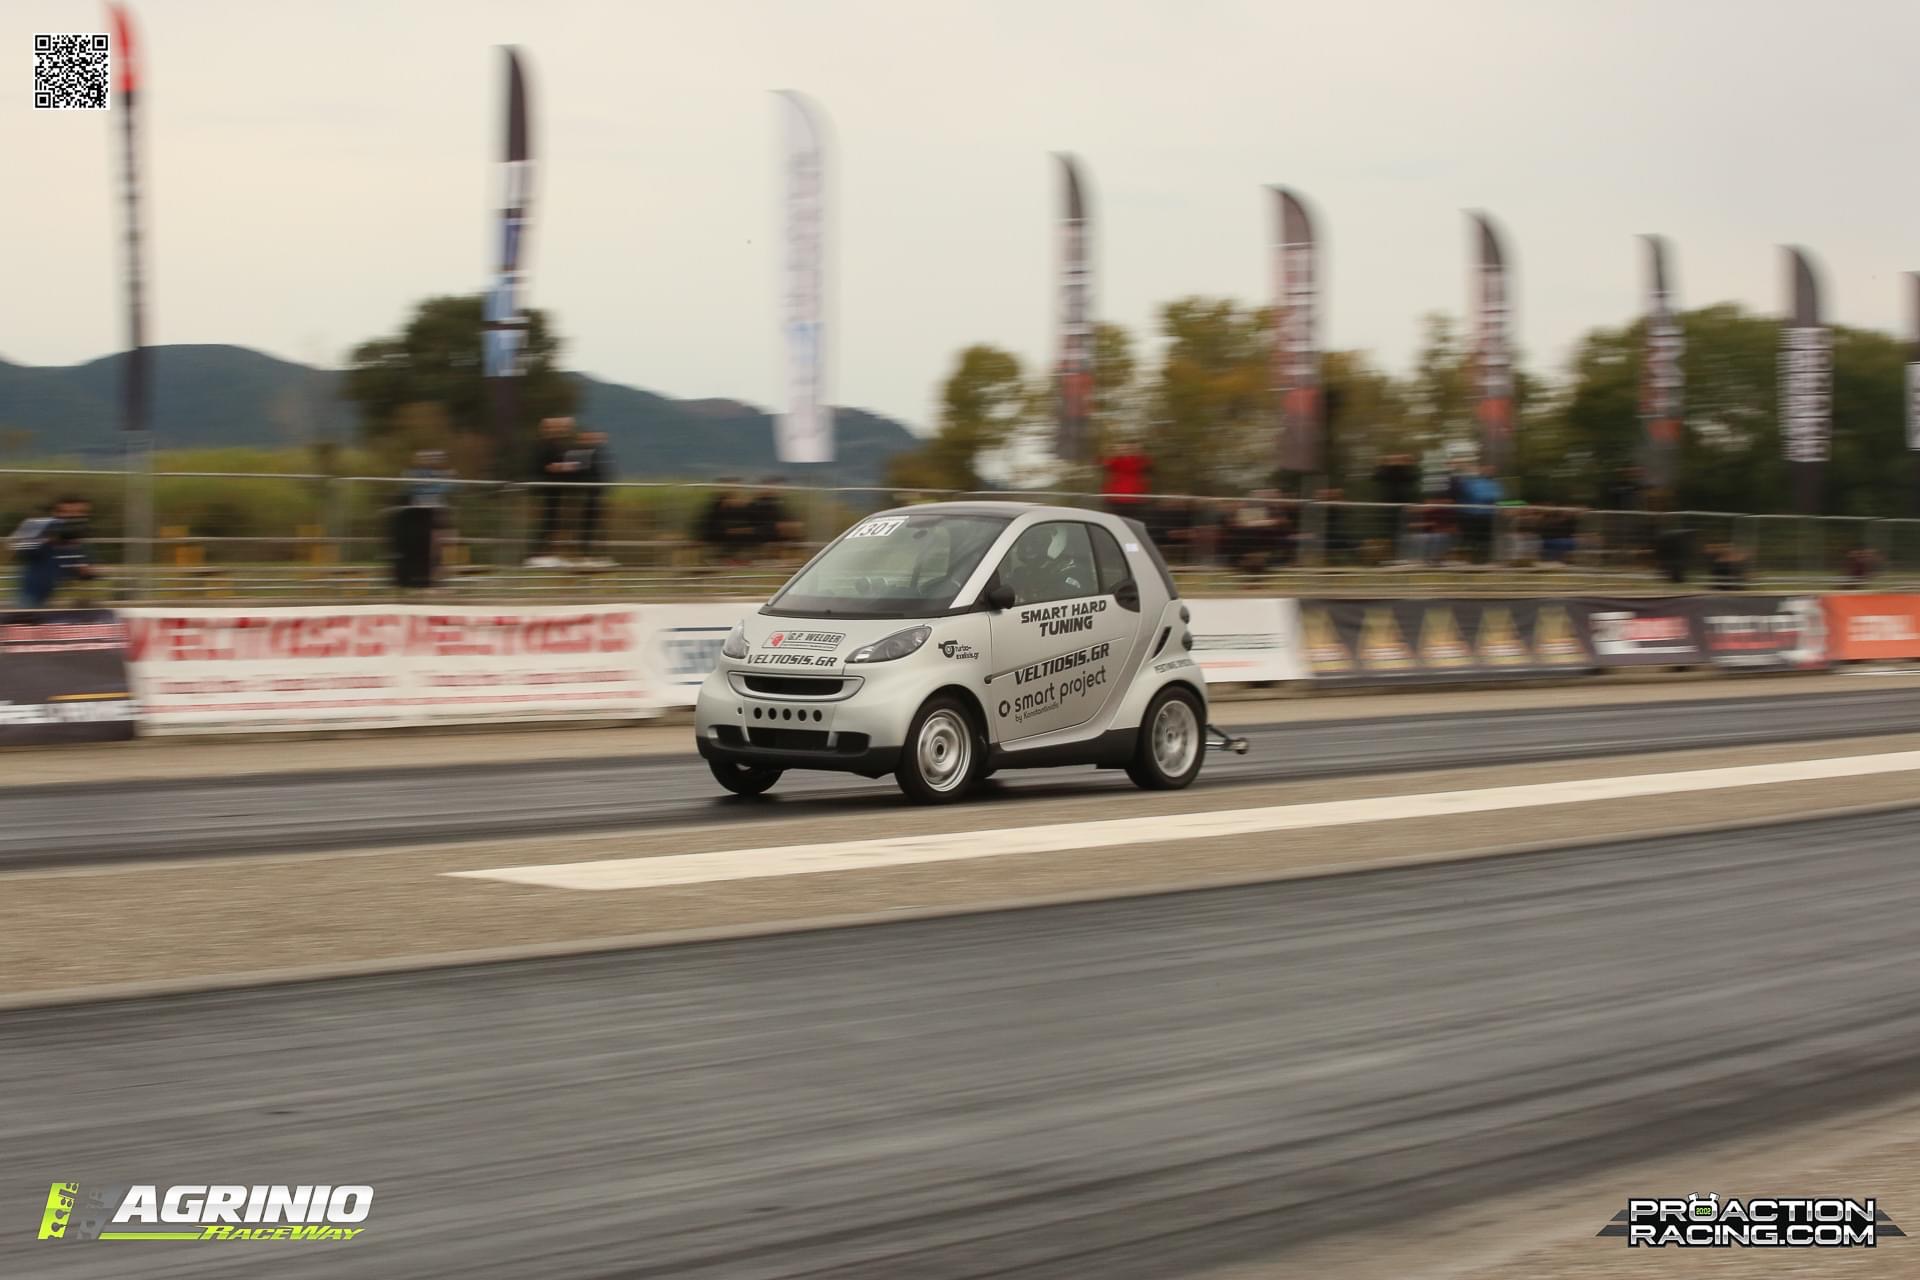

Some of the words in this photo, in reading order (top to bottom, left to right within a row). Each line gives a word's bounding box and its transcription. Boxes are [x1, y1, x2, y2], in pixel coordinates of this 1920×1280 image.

[1021, 605, 1068, 624] SMART
[1072, 599, 1107, 617] HARD
[1039, 615, 1093, 637] TUNING
[805, 633, 842, 644] WELDER
[747, 654, 838, 667] VELTIOSIS.GR
[1015, 643, 1110, 685] VELTIOSIS.GR
[1014, 682, 1056, 713] smart
[1059, 664, 1107, 704] project
